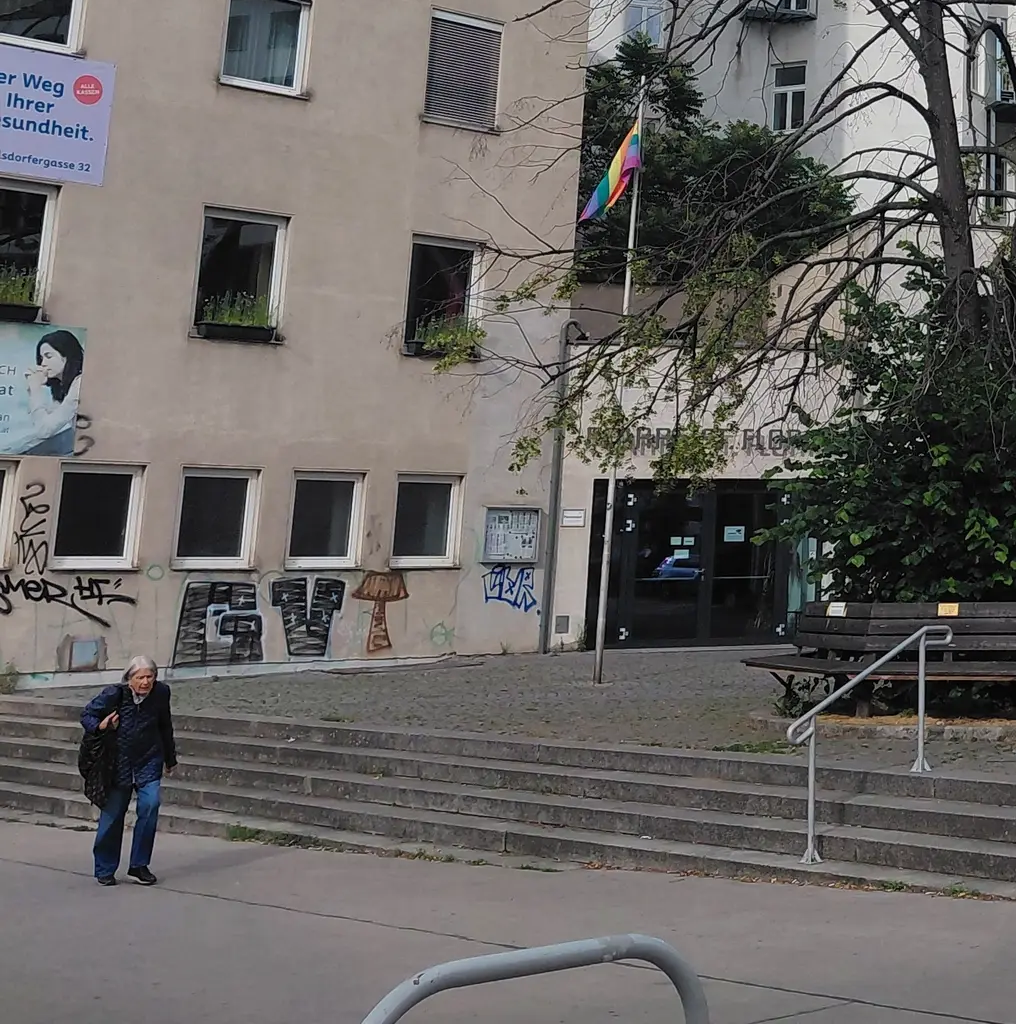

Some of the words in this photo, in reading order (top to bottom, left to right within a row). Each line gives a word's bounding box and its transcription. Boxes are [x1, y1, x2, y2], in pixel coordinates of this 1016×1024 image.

[23, 73, 64, 98] Weg
[7, 92, 54, 113] Ihrer
[0, 116, 94, 141] sundheit.
[0, 150, 75, 170] sdorfergasse
[78, 163, 91, 172] 32
